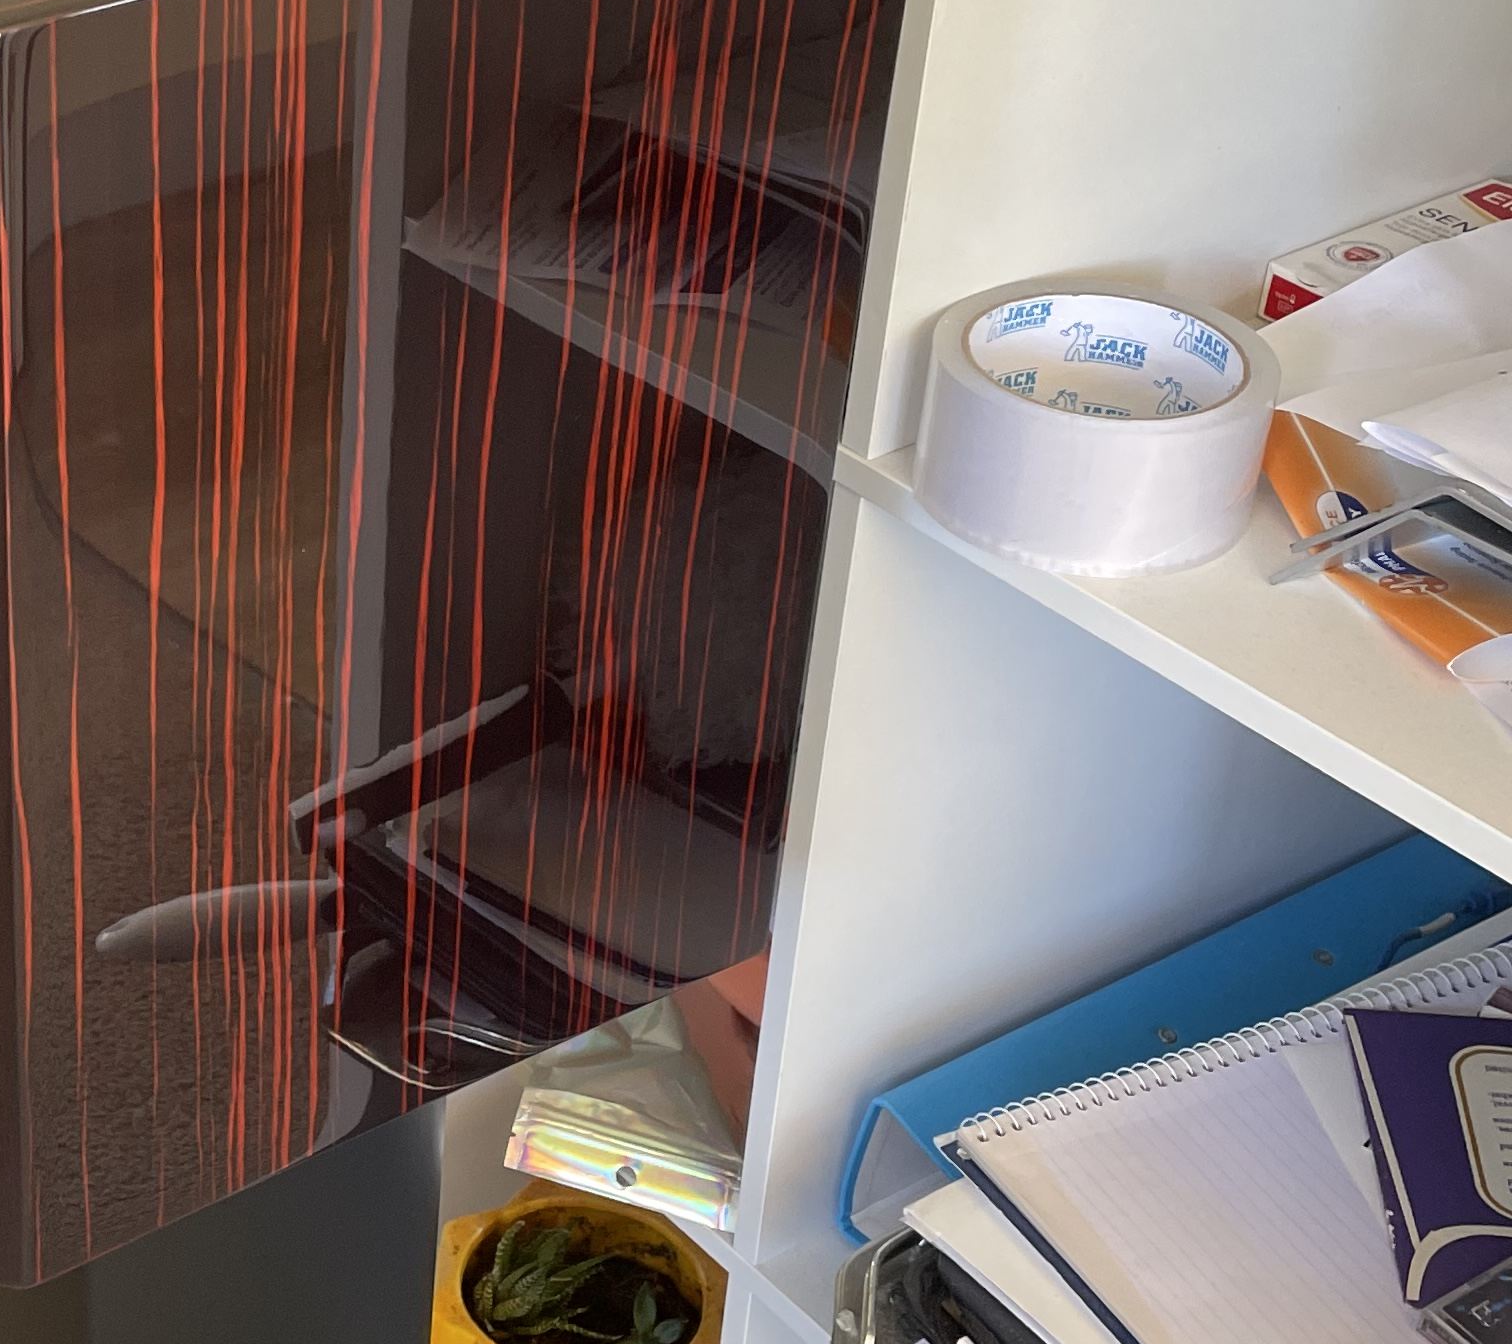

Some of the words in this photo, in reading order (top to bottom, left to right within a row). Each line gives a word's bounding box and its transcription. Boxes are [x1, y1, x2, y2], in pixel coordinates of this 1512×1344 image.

[1002, 316, 1047, 332] HAMMER
[1004, 301, 1053, 324] JACK
[1089, 337, 1149, 361] JACK
[1194, 328, 1230, 362] JACK
[1087, 350, 1145, 369] HAMMER
[1191, 342, 1227, 373] HAMMER
[1000, 371, 1038, 387] ACK
